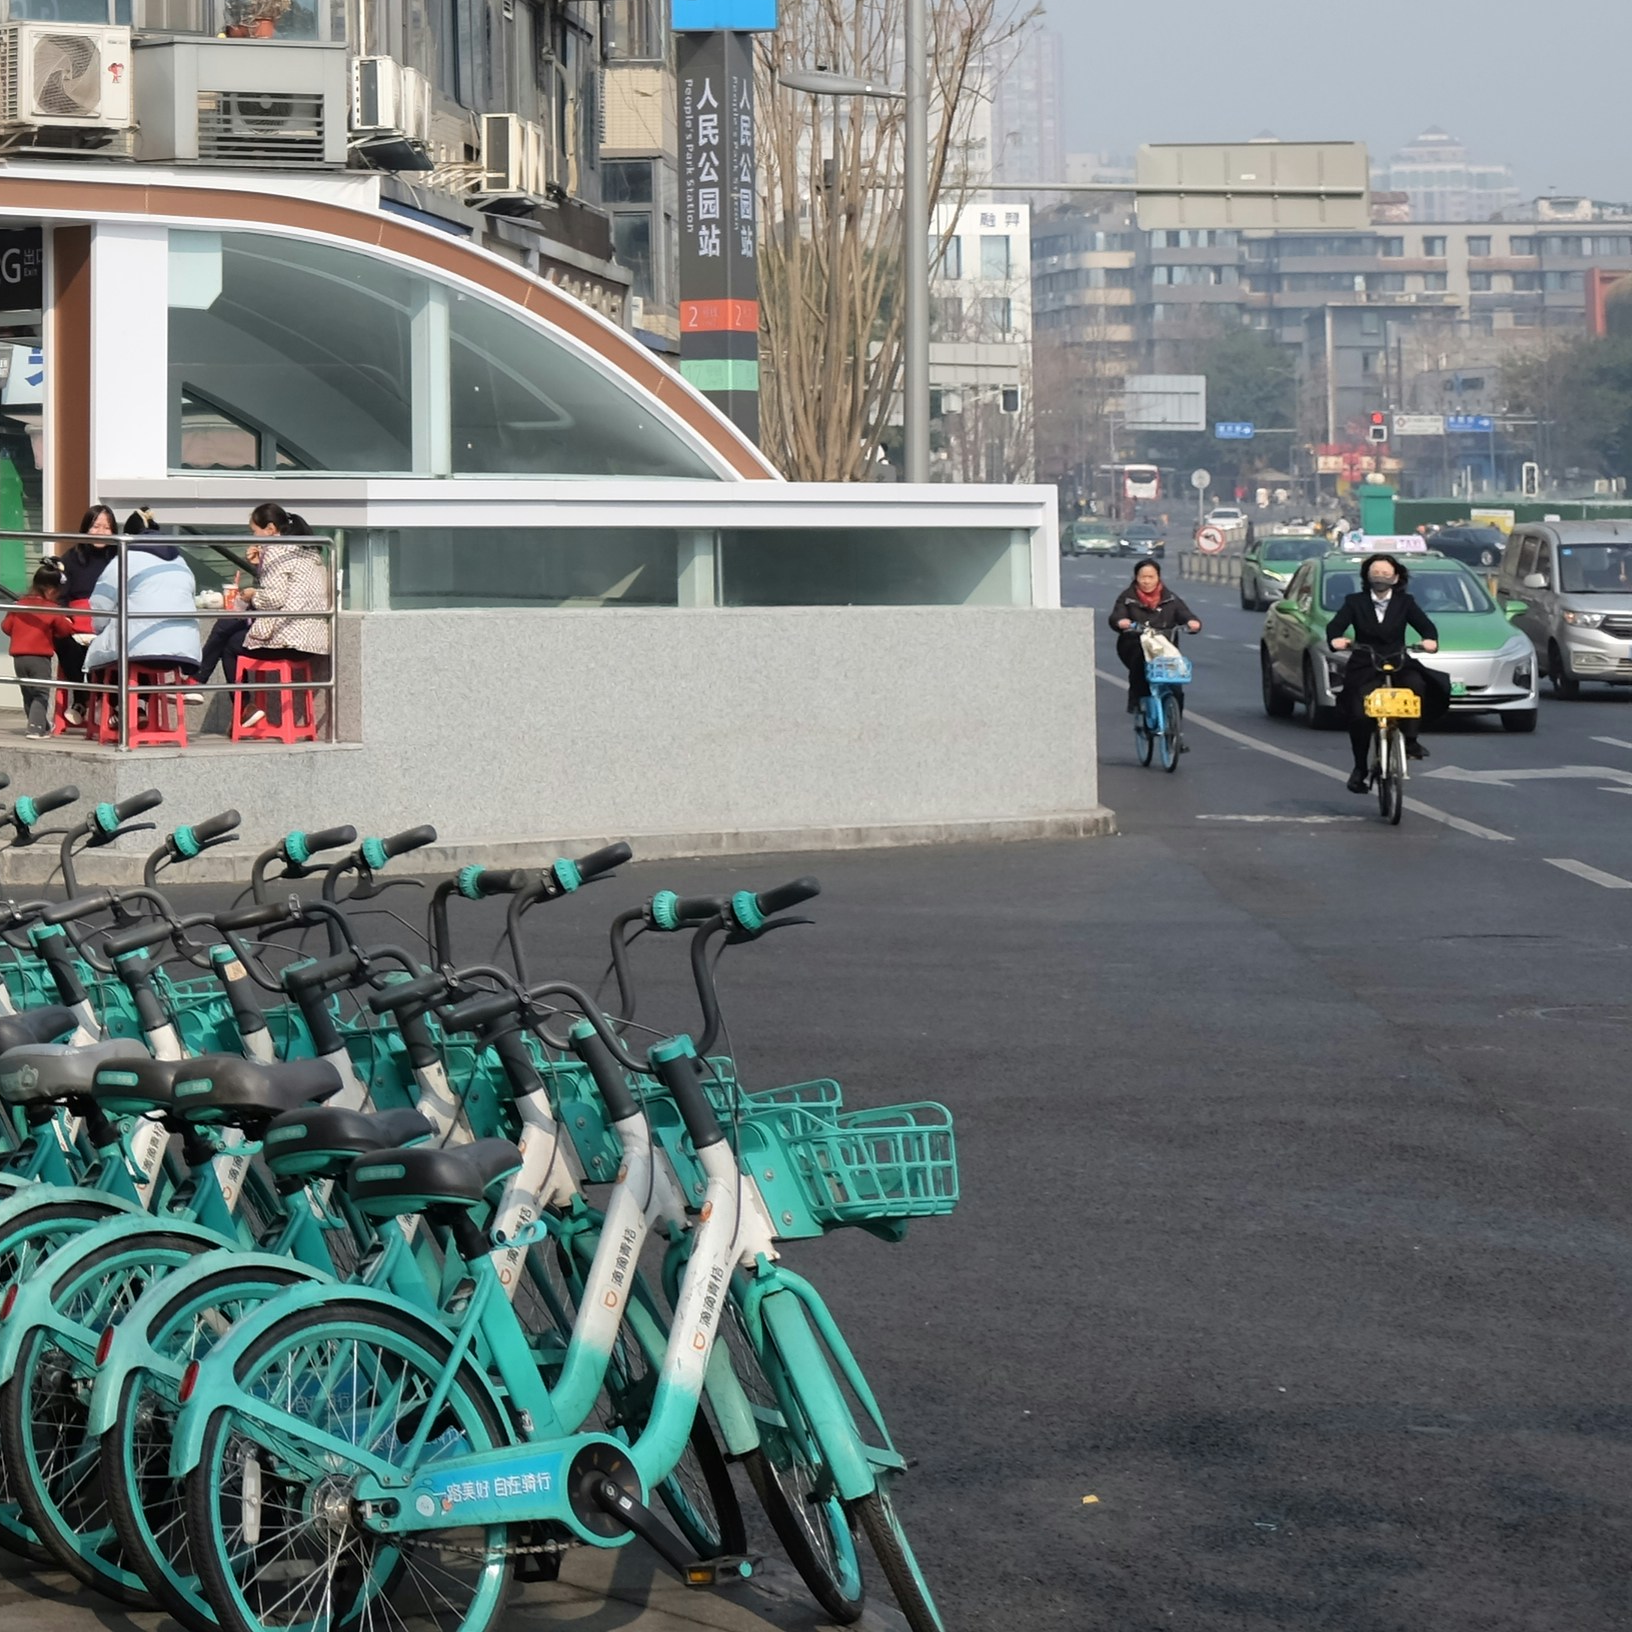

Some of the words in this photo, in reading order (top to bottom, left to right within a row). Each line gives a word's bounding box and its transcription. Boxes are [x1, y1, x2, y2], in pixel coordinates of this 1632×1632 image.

[684, 143, 694, 176] Park
[696, 77, 721, 259] 人民公园站
[739, 77, 754, 259] 人民公园站
[685, 179, 695, 234] Station
[0, 247, 23, 285] G
[688, 305, 699, 328] 2
[735, 304, 742, 327] 2
[610, 1227, 638, 1288] 滴滴青桔
[698, 1265, 726, 1329] 滴滴青桔
[432, 1480, 490, 1503] 一路美好
[493, 1472, 552, 1498] 自在骑行
